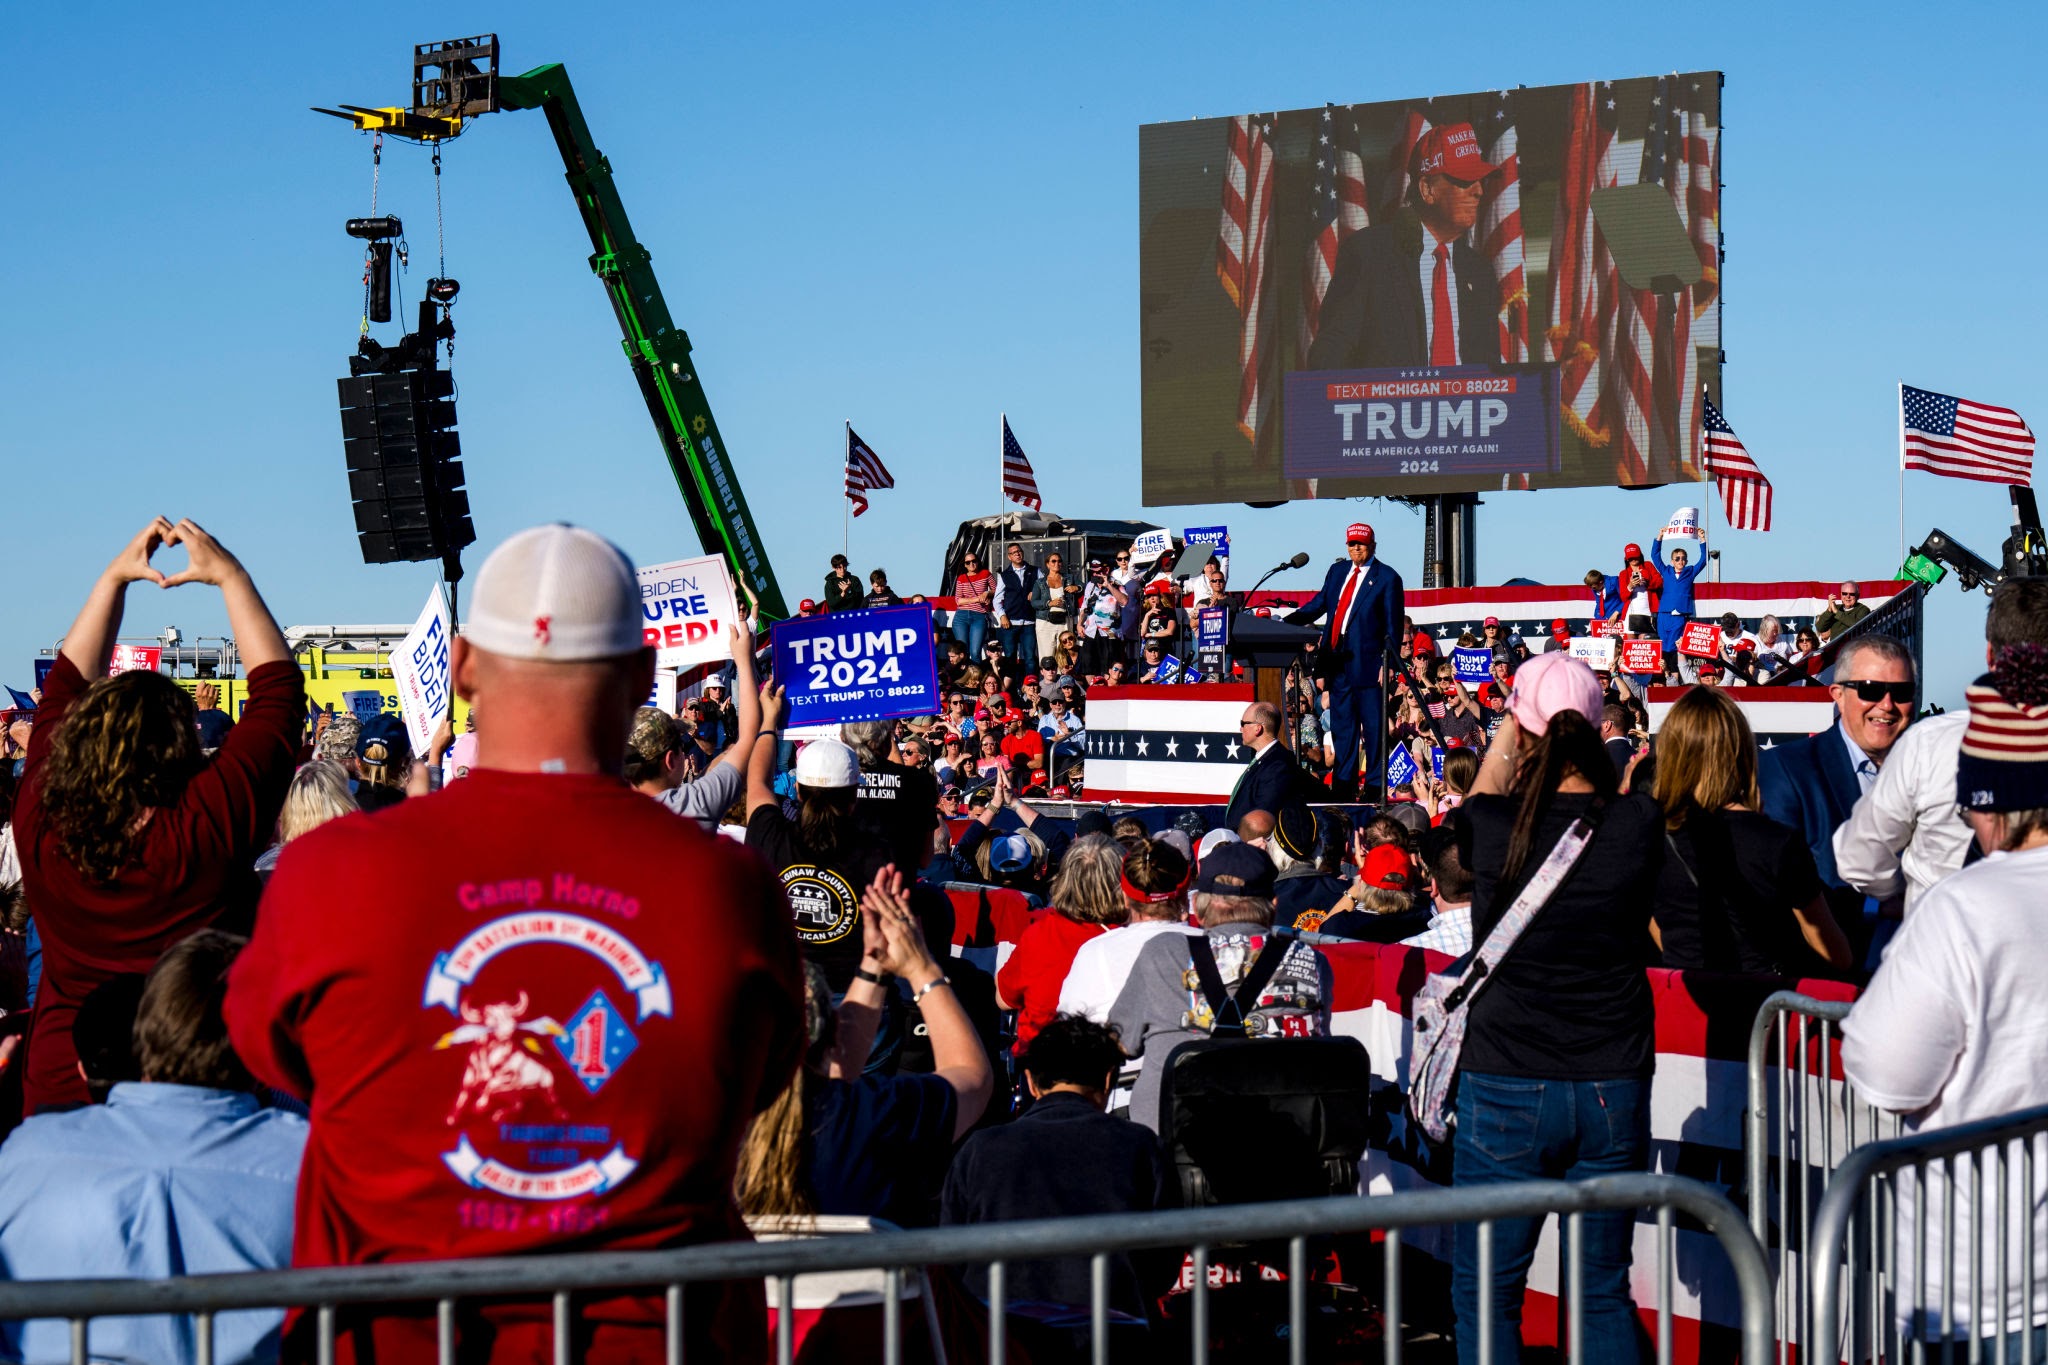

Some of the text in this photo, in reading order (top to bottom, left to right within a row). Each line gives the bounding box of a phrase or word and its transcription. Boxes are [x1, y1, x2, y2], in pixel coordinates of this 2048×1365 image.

[1335, 380, 1509, 398] TEXT MICHIGAN TO 88022
[1334, 399, 1508, 441] TRUMP
[1342, 444, 1499, 457] MAKE AMERICA GREAT AGAIN!
[1400, 460, 1439, 474] 2024
[701, 435, 768, 593] SUNBELT RENTAS
[1137, 534, 1165, 546] FIRE
[1189, 532, 1224, 542] TRUMP
[1138, 544, 1166, 555] BIDEN
[641, 576, 699, 598] BIDEN,
[642, 594, 709, 621] U'RE
[1203, 619, 1222, 634] TRUMP
[1693, 626, 1712, 634] MAKE
[642, 619, 719, 650] RED!
[1687, 631, 1715, 642] AMERICA
[789, 628, 917, 665] TRUMP
[1688, 645, 1711, 653] AGAIN!
[1690, 638, 1711, 647] GREAT
[1456, 653, 1487, 665] TRUMP
[808, 656, 902, 690] 2024
[1460, 663, 1483, 672] 2024
[413, 640, 446, 719] BIDEN
[789, 685, 925, 706] TEXT TRUMP TO 88022
[353, 698, 379, 711] FIRE
[408, 673, 420, 700] TRUMP
[419, 712, 430, 738] 88022
[869, 789, 895, 799] ALASKA
[780, 868, 852, 900] GINAW COUNTY
[457, 872, 641, 919] Camp Horno
[792, 899, 826, 907] AMERICA
[792, 903, 828, 912] FIRST
[797, 932, 827, 941] LICAN
